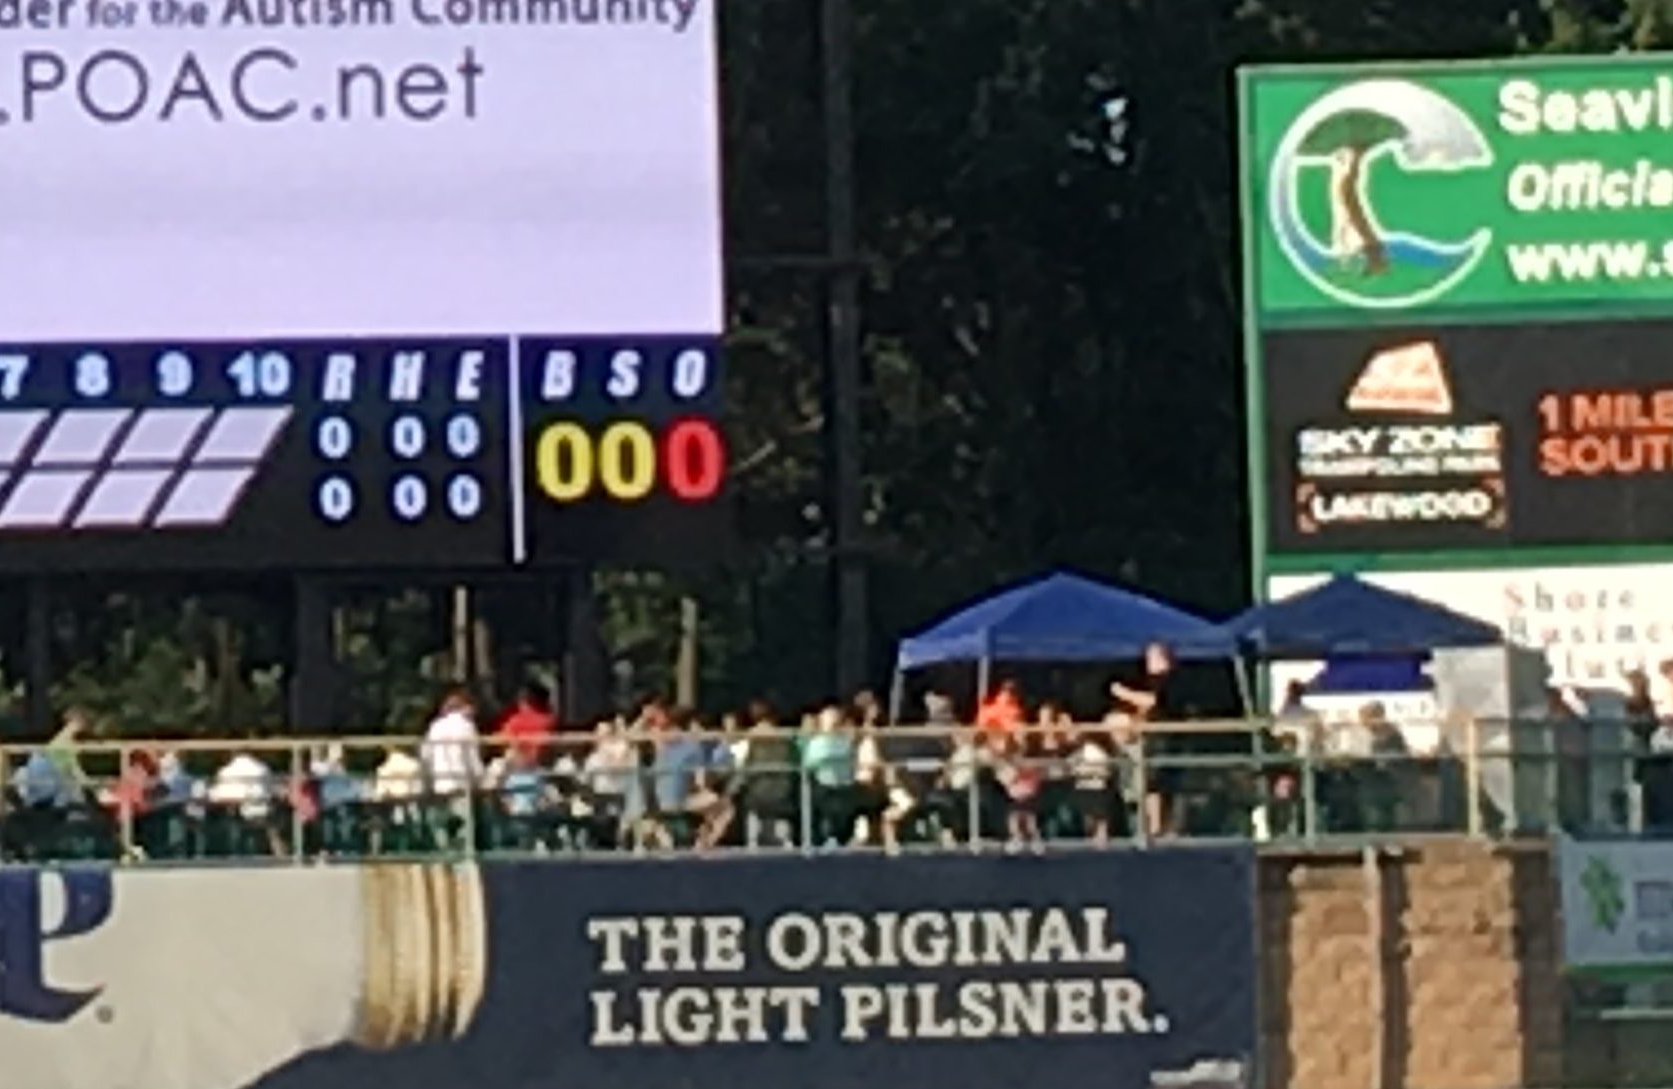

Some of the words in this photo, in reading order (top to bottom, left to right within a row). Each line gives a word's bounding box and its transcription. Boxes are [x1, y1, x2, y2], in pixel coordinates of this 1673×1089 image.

[75, 353, 110, 398] 8
[157, 351, 192, 396] 9
[227, 351, 290, 397] 10
[322, 353, 356, 402] R
[389, 351, 425, 401] H
[455, 350, 484, 401] E
[542, 350, 576, 400] B
[607, 349, 641, 397] S
[1538, 394, 1559, 431] 1
[1572, 391, 1673, 431] MILE
[318, 416, 351, 459] 0
[393, 415, 425, 458] 0
[447, 414, 480, 458] 0
[1540, 434, 1673, 476] SOUT
[319, 477, 352, 520] 0
[393, 475, 427, 519] 0
[448, 474, 481, 517] 0
[1311, 489, 1492, 523] LAKEWOOD
[587, 916, 745, 973] THE
[767, 908, 1126, 970] ORIGINAL
[590, 987, 820, 1046] LIGHT
[840, 978, 1170, 1040] PILSNER.
